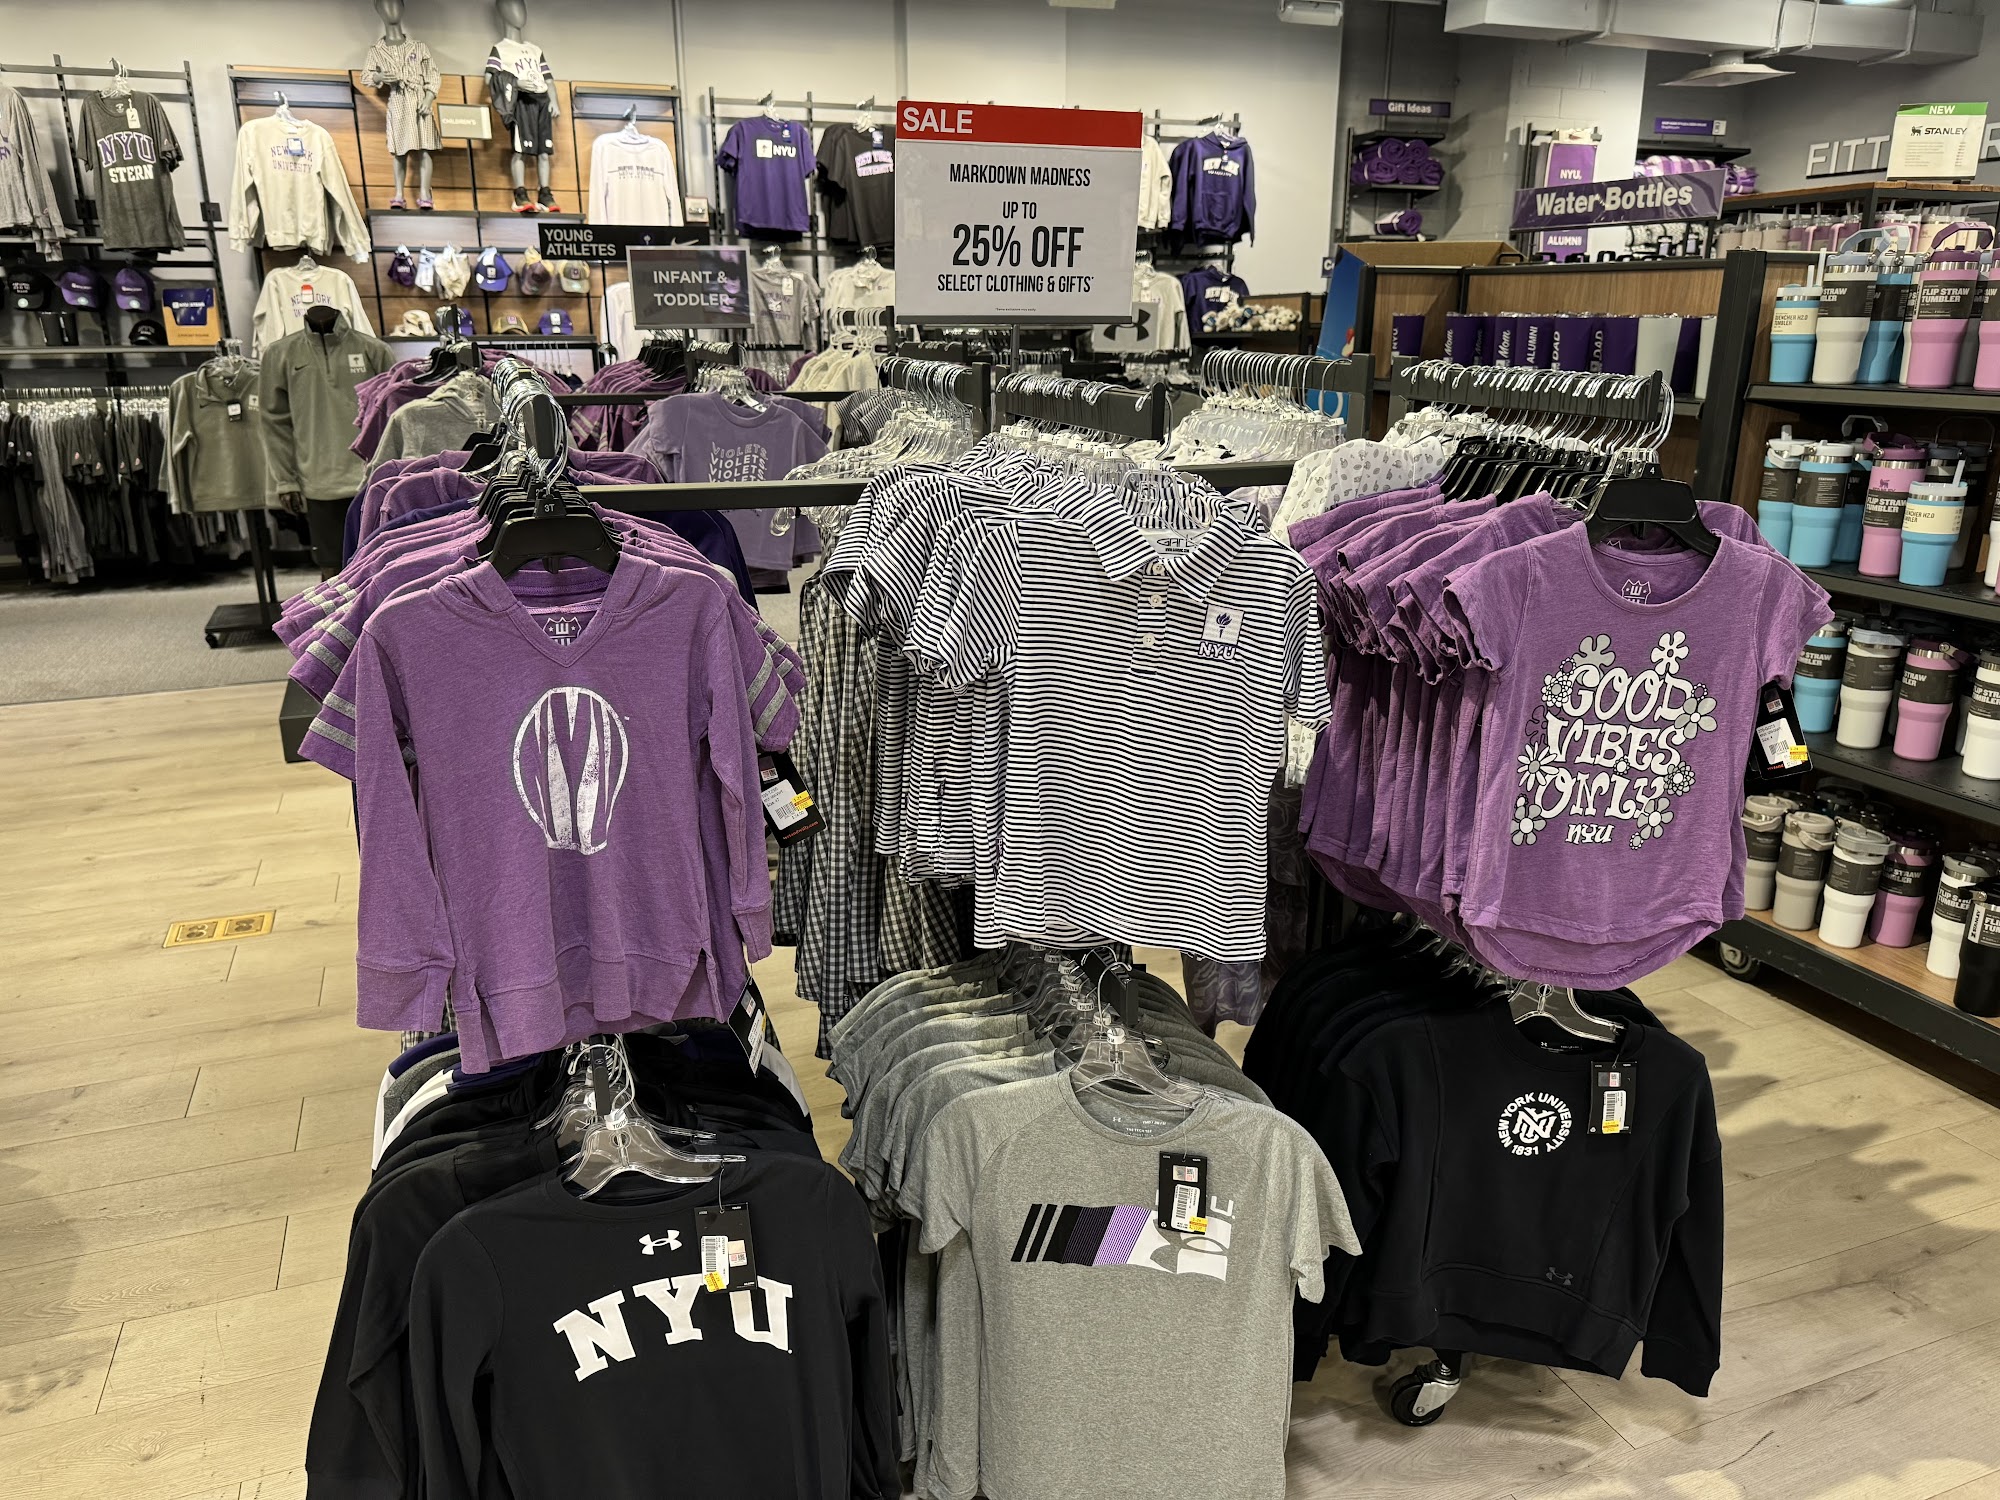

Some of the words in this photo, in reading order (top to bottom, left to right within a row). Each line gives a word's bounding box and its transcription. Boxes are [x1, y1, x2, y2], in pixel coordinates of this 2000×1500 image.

[1388, 102, 1406, 112] Gift
[1407, 103, 1432, 113] Ideas
[1929, 105, 1955, 115] NEW
[902, 107, 973, 134] SALE
[1924, 127, 1967, 136] STANLEY
[97, 131, 156, 168] NYU
[773, 145, 796, 158] NYU
[1806, 134, 1891, 176] FITT
[108, 164, 154, 183] STERN
[950, 163, 1026, 184] MARKDOWN
[1030, 166, 1091, 187] MADNESS
[1535, 191, 1600, 216] Water
[1604, 182, 1693, 211] Bottles
[1002, 201, 1018, 219] UP
[1022, 202, 1037, 219] TO
[544, 229, 594, 242] YOUNG
[1547, 236, 1582, 246] ALUMNI
[546, 243, 616, 257] ATHLETES
[952, 224, 1021, 267] 25%
[1031, 226, 1084, 267] OFF
[653, 271, 713, 284] INFANT
[717, 271, 728, 284] &
[937, 274, 983, 291] SELECT
[986, 275, 1043, 292] CLOTHING
[1047, 276, 1055, 292] &
[654, 293, 730, 307] TODDLER
[1921, 295, 1961, 303] TUMBLER
[1444, 329, 1454, 356] Mom
[1498, 330, 1511, 358] Mom
[1526, 325, 1538, 364] ALUMNI
[1552, 331, 1560, 361] DAD
[1593, 330, 1603, 359] DAD
[1650, 466, 1655, 474] 4
[544, 503, 555, 512] 3T
[1866, 503, 1899, 513] TUMBLER
[1198, 640, 1236, 660] NYU
[1805, 652, 1832, 661] STRAW
[1903, 671, 1927, 681] STRAW
[1562, 664, 1694, 723] GOOD
[1983, 689, 2000, 699] STRA
[1546, 711, 1686, 775] VIBES
[1535, 771, 1667, 819] ONLY
[1893, 869, 1922, 879] STRAW
[1940, 889, 1952, 898] FLIP
[1502, 1092, 1536, 1118] YORK
[1538, 1092, 1572, 1152] UNIVERSITY
[1497, 1119, 1513, 1148] NEW
[1511, 1144, 1539, 1156] 1831
[553, 1273, 793, 1382] NYU
